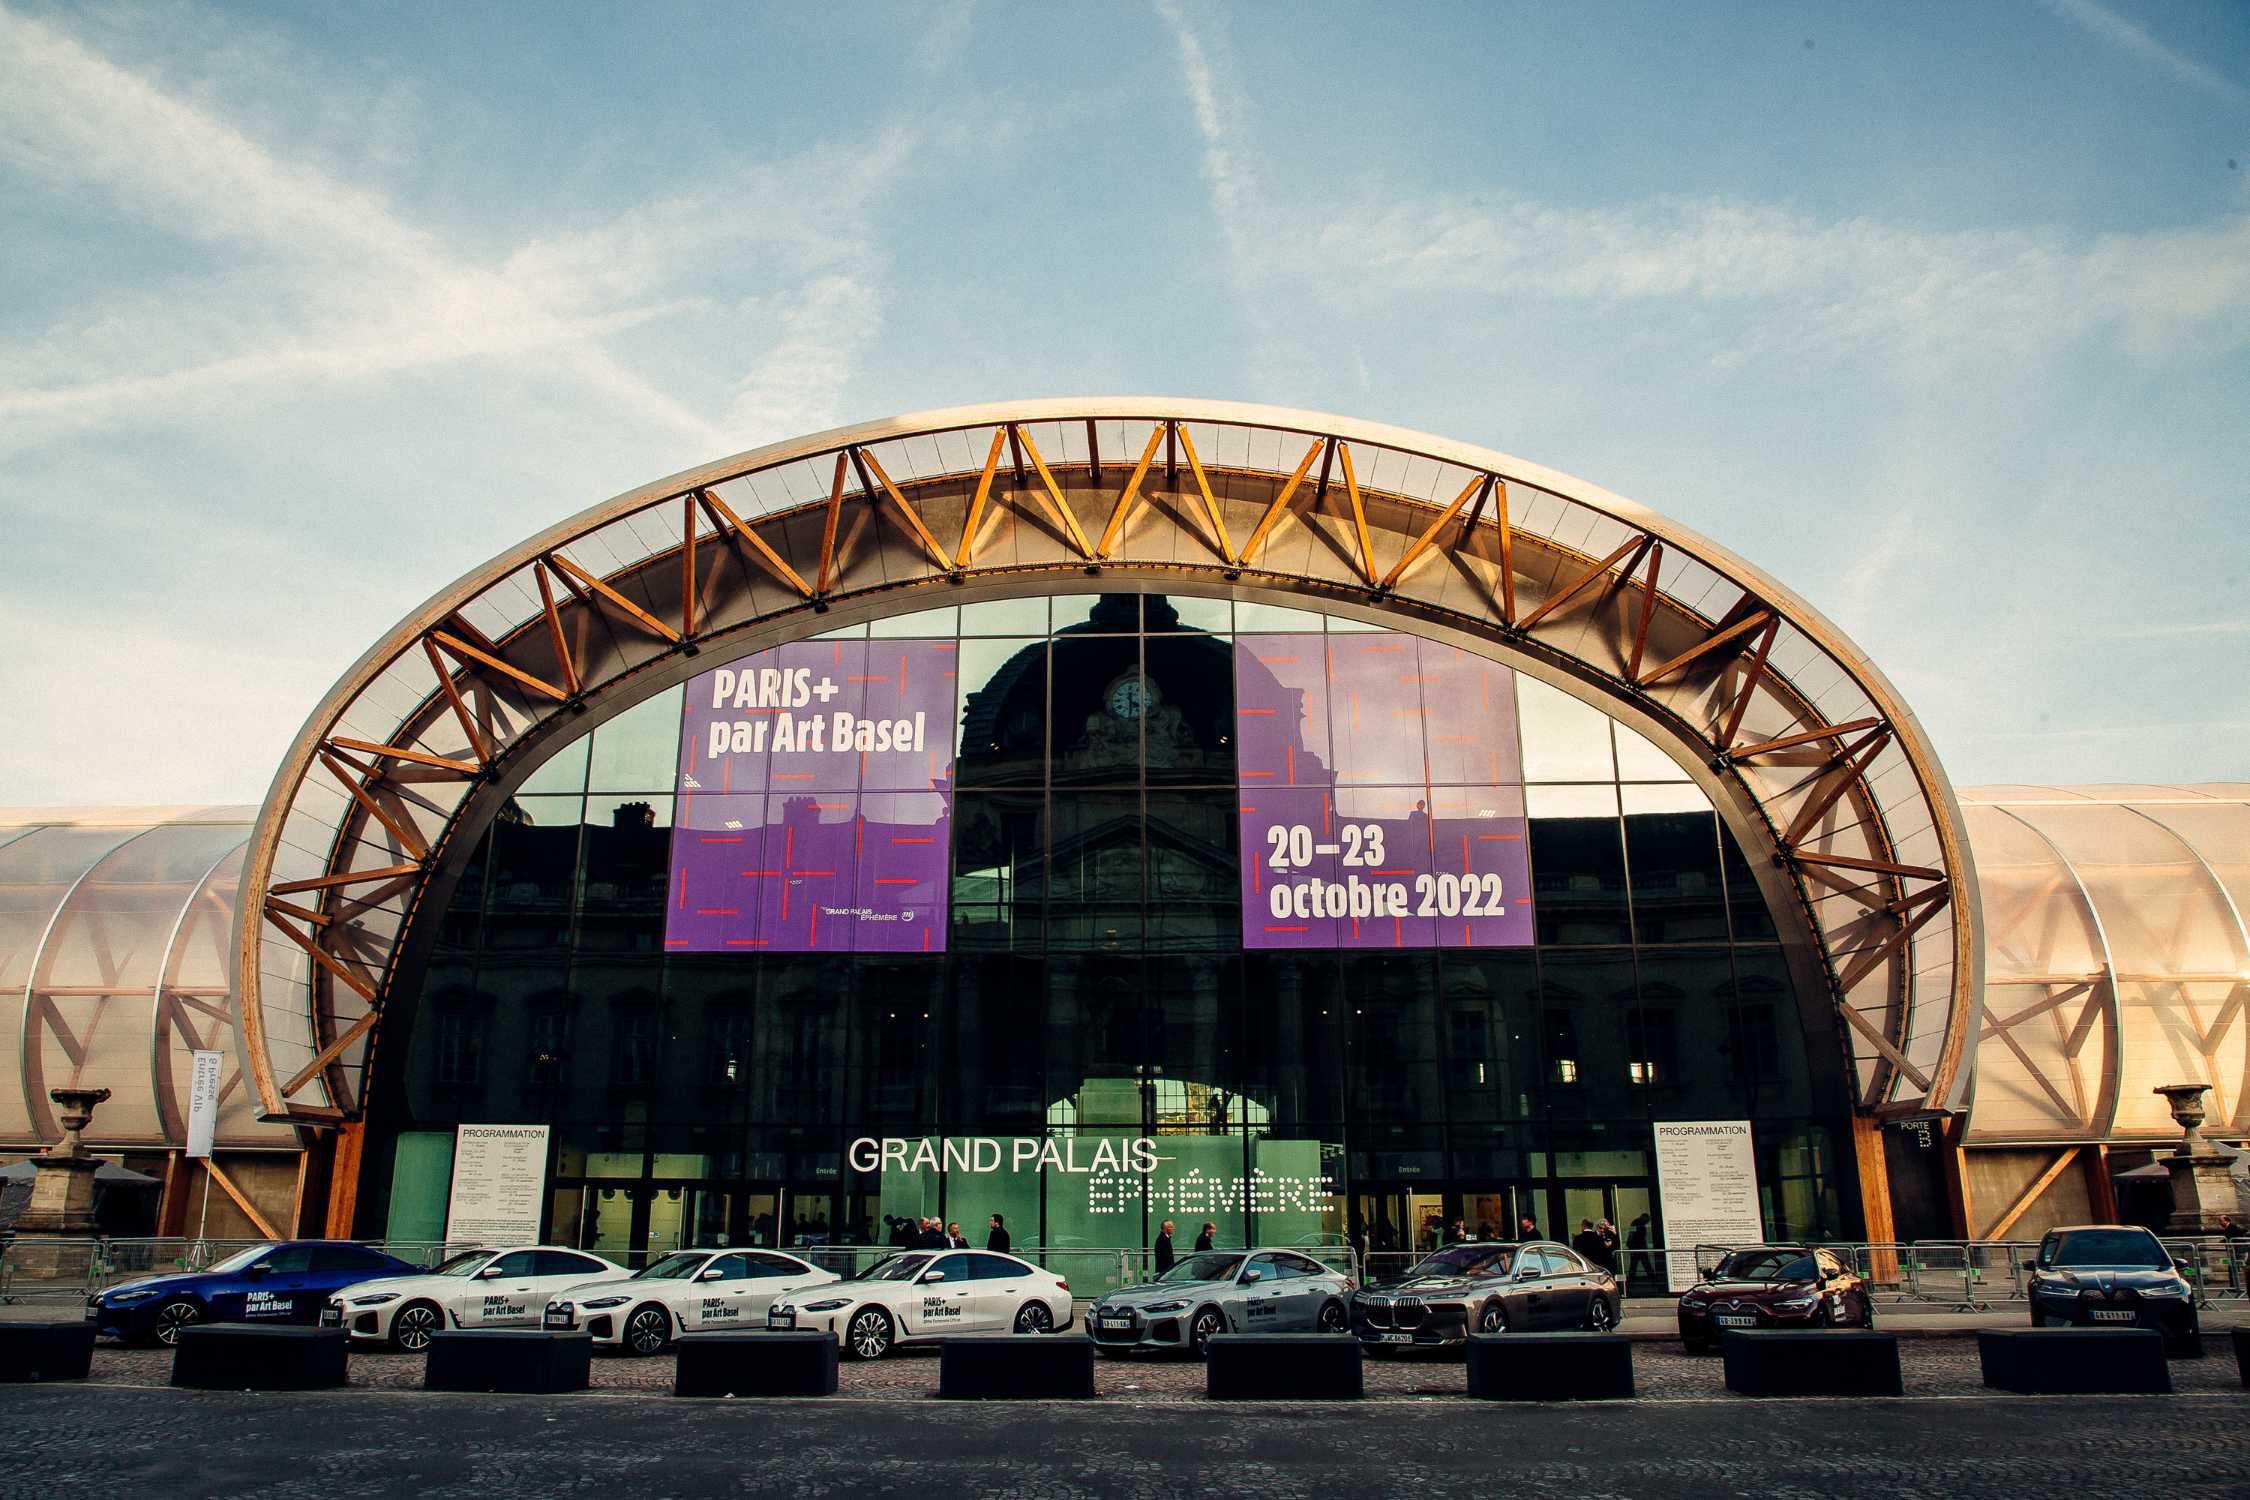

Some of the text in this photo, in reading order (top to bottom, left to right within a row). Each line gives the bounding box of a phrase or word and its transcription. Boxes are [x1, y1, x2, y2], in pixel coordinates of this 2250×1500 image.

[712, 668, 839, 709] PARIS+
[708, 712, 926, 759] par Art Basel
[1270, 873, 1505, 918] octobre 2022
[1659, 1126, 1747, 1136] PROGRAMMATION
[1900, 1121, 1930, 1130] PORTE
[463, 1129, 545, 1139] PROGRAMMATION
[1918, 1130, 1932, 1148] B
[849, 1137, 1160, 1173] GRAND PALAIS
[1088, 1168, 1335, 1214] ÉPHÉMÈRE
[247, 1291, 275, 1301] PARIS+
[484, 1296, 509, 1306] PARIS+
[923, 1297, 946, 1307] PARIS+
[246, 1300, 293, 1313] par Art Basel
[702, 1298, 725, 1308] PARIS+
[483, 1305, 526, 1316] par Art Basel
[702, 1307, 739, 1319] par Art Basel
[923, 1305, 961, 1318] par Art Basel
